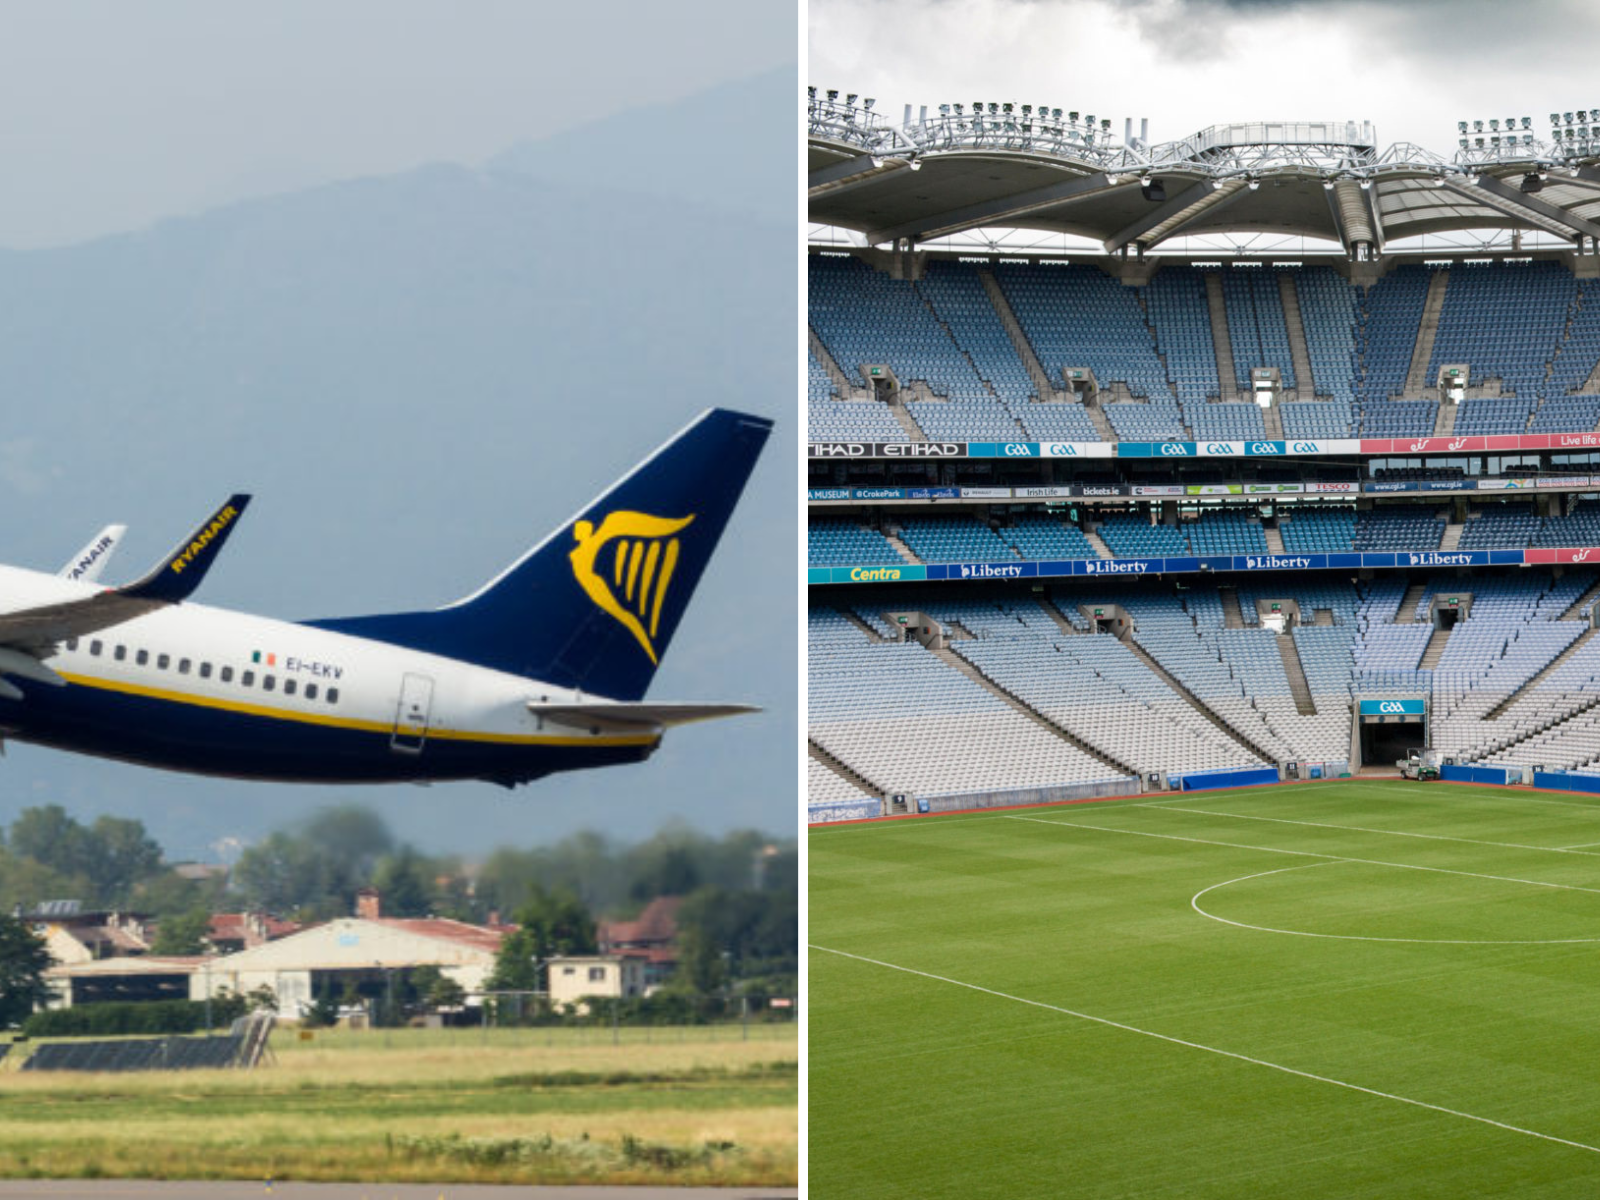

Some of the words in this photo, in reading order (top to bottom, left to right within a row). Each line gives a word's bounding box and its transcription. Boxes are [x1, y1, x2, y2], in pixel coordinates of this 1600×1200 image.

[1561, 436, 1580, 445] Live
[1583, 435, 1597, 445] life
[883, 444, 959, 456] ETIHAD
[814, 490, 849, 499] MUSEUM
[856, 489, 900, 498] @CrokePark
[1027, 488, 1044, 496] Irish
[1045, 488, 1058, 496] Life
[1083, 487, 1120, 495] tickets.ie
[170, 505, 238, 574] RYANAIR
[68, 535, 114, 580] ANAIR
[1257, 556, 1311, 569] Liberty
[1420, 552, 1473, 565] Liberty
[970, 564, 1022, 578] Liberty
[1095, 560, 1148, 574] Liberty
[850, 567, 901, 581] Centra
